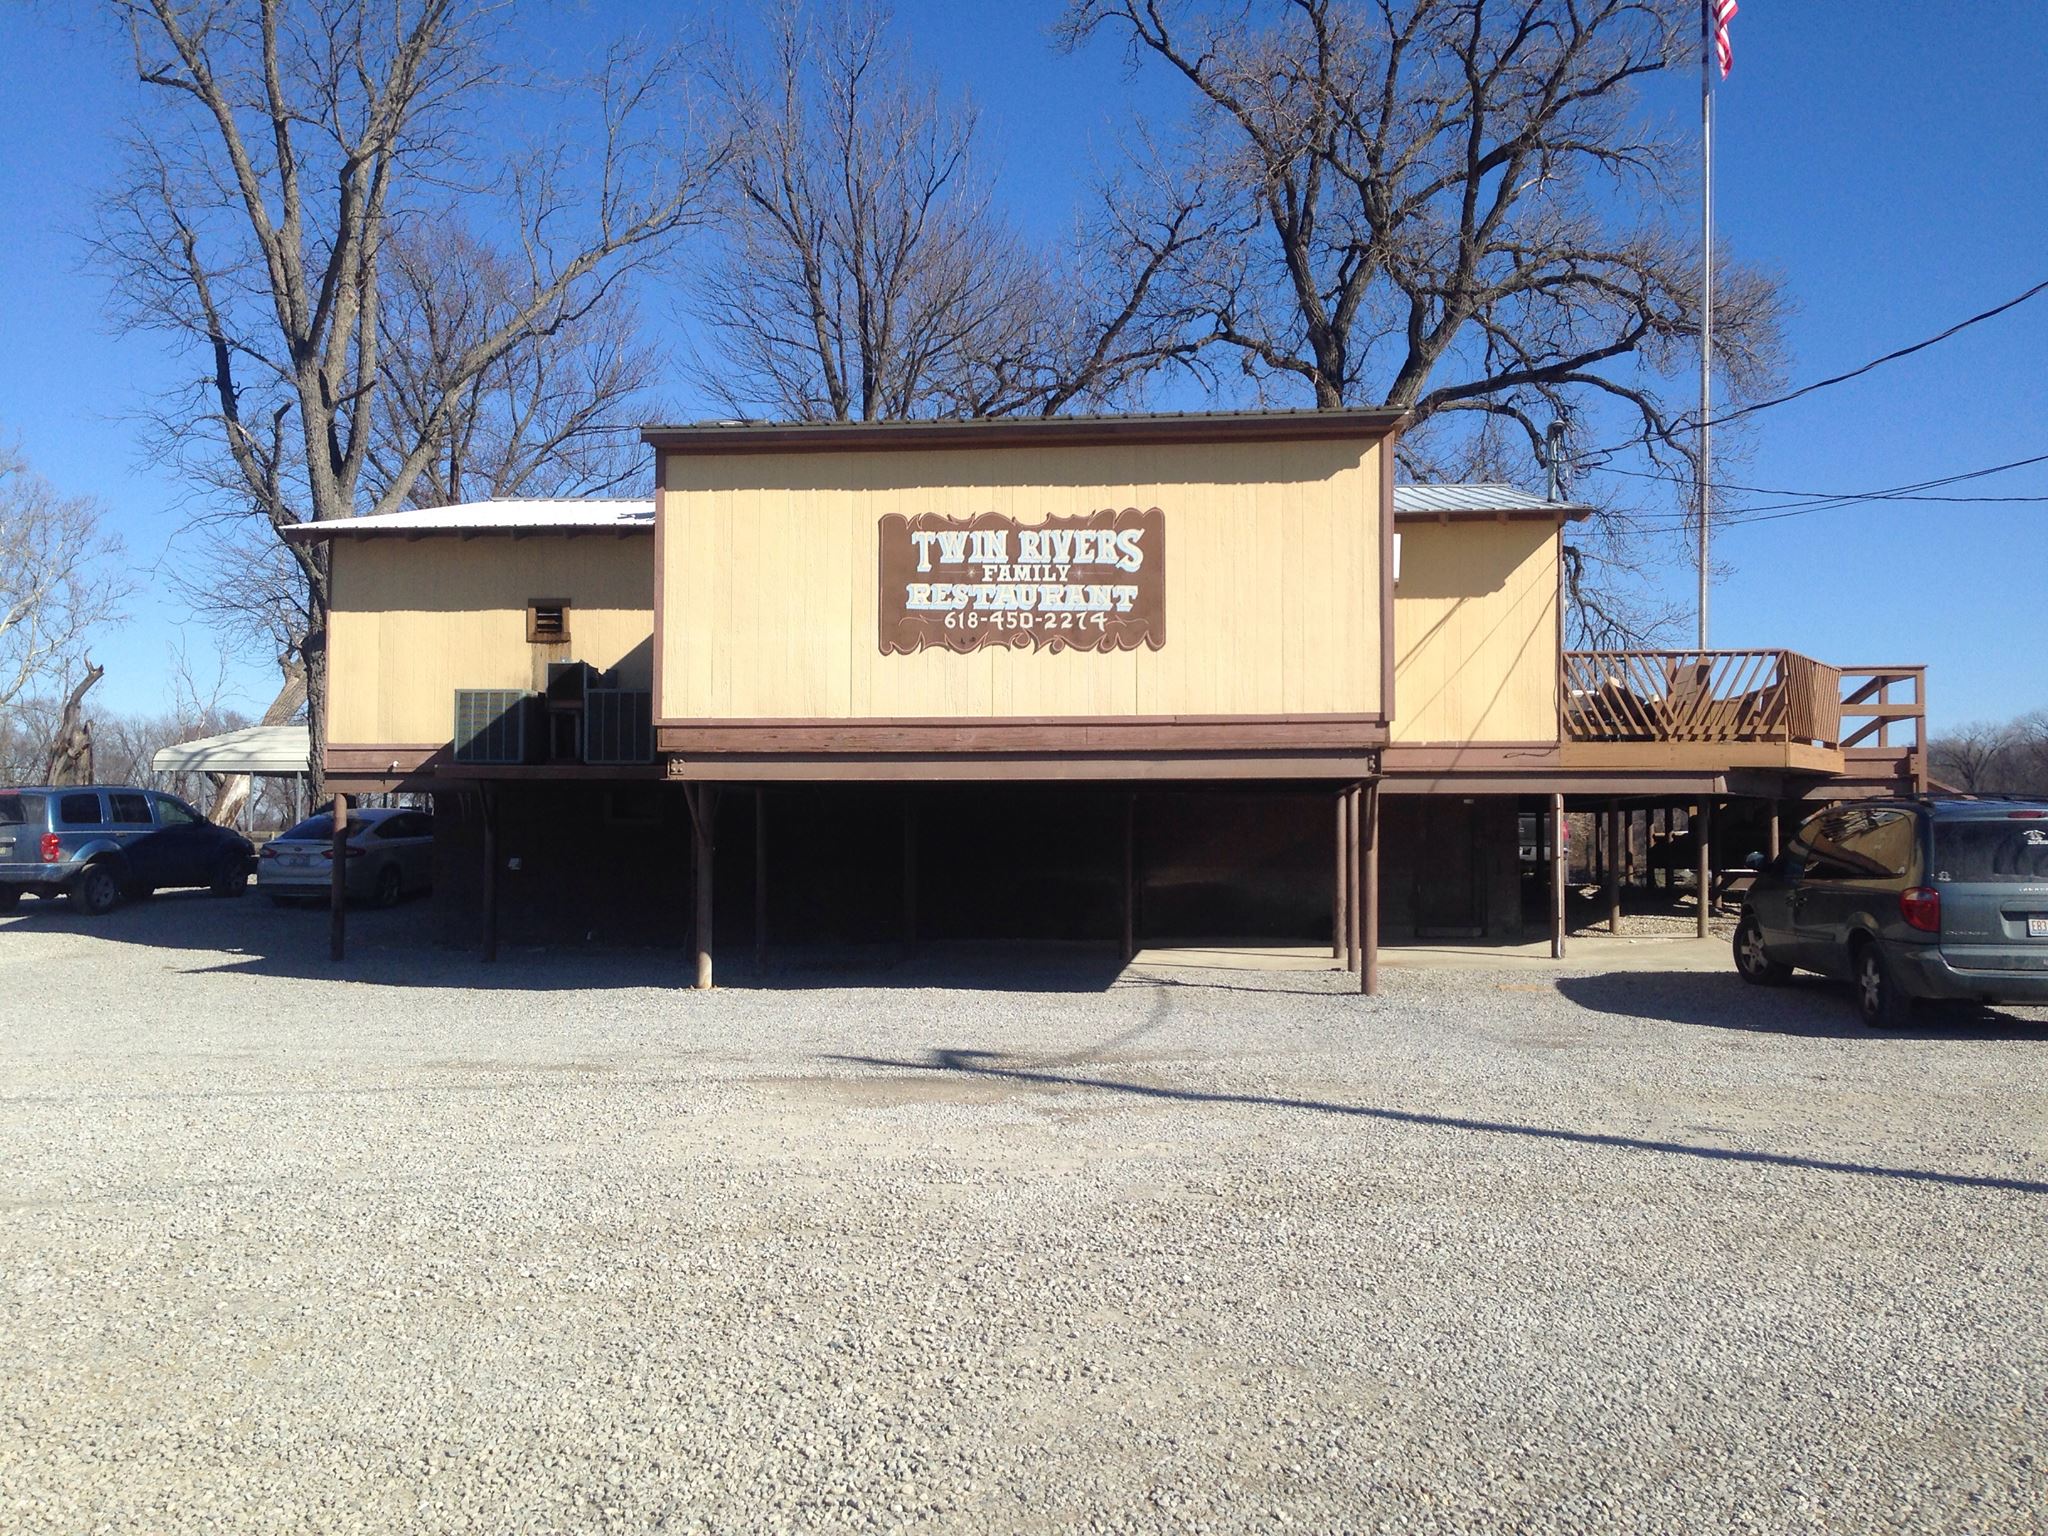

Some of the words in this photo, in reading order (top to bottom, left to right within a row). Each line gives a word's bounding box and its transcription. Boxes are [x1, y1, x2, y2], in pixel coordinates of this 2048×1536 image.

[911, 529, 1009, 572] TWIN
[1018, 528, 1145, 573] RIVERS
[981, 564, 1071, 582] FAMILY
[906, 583, 1138, 612] RESTAURANT
[944, 611, 1108, 631] 618-450-2274
